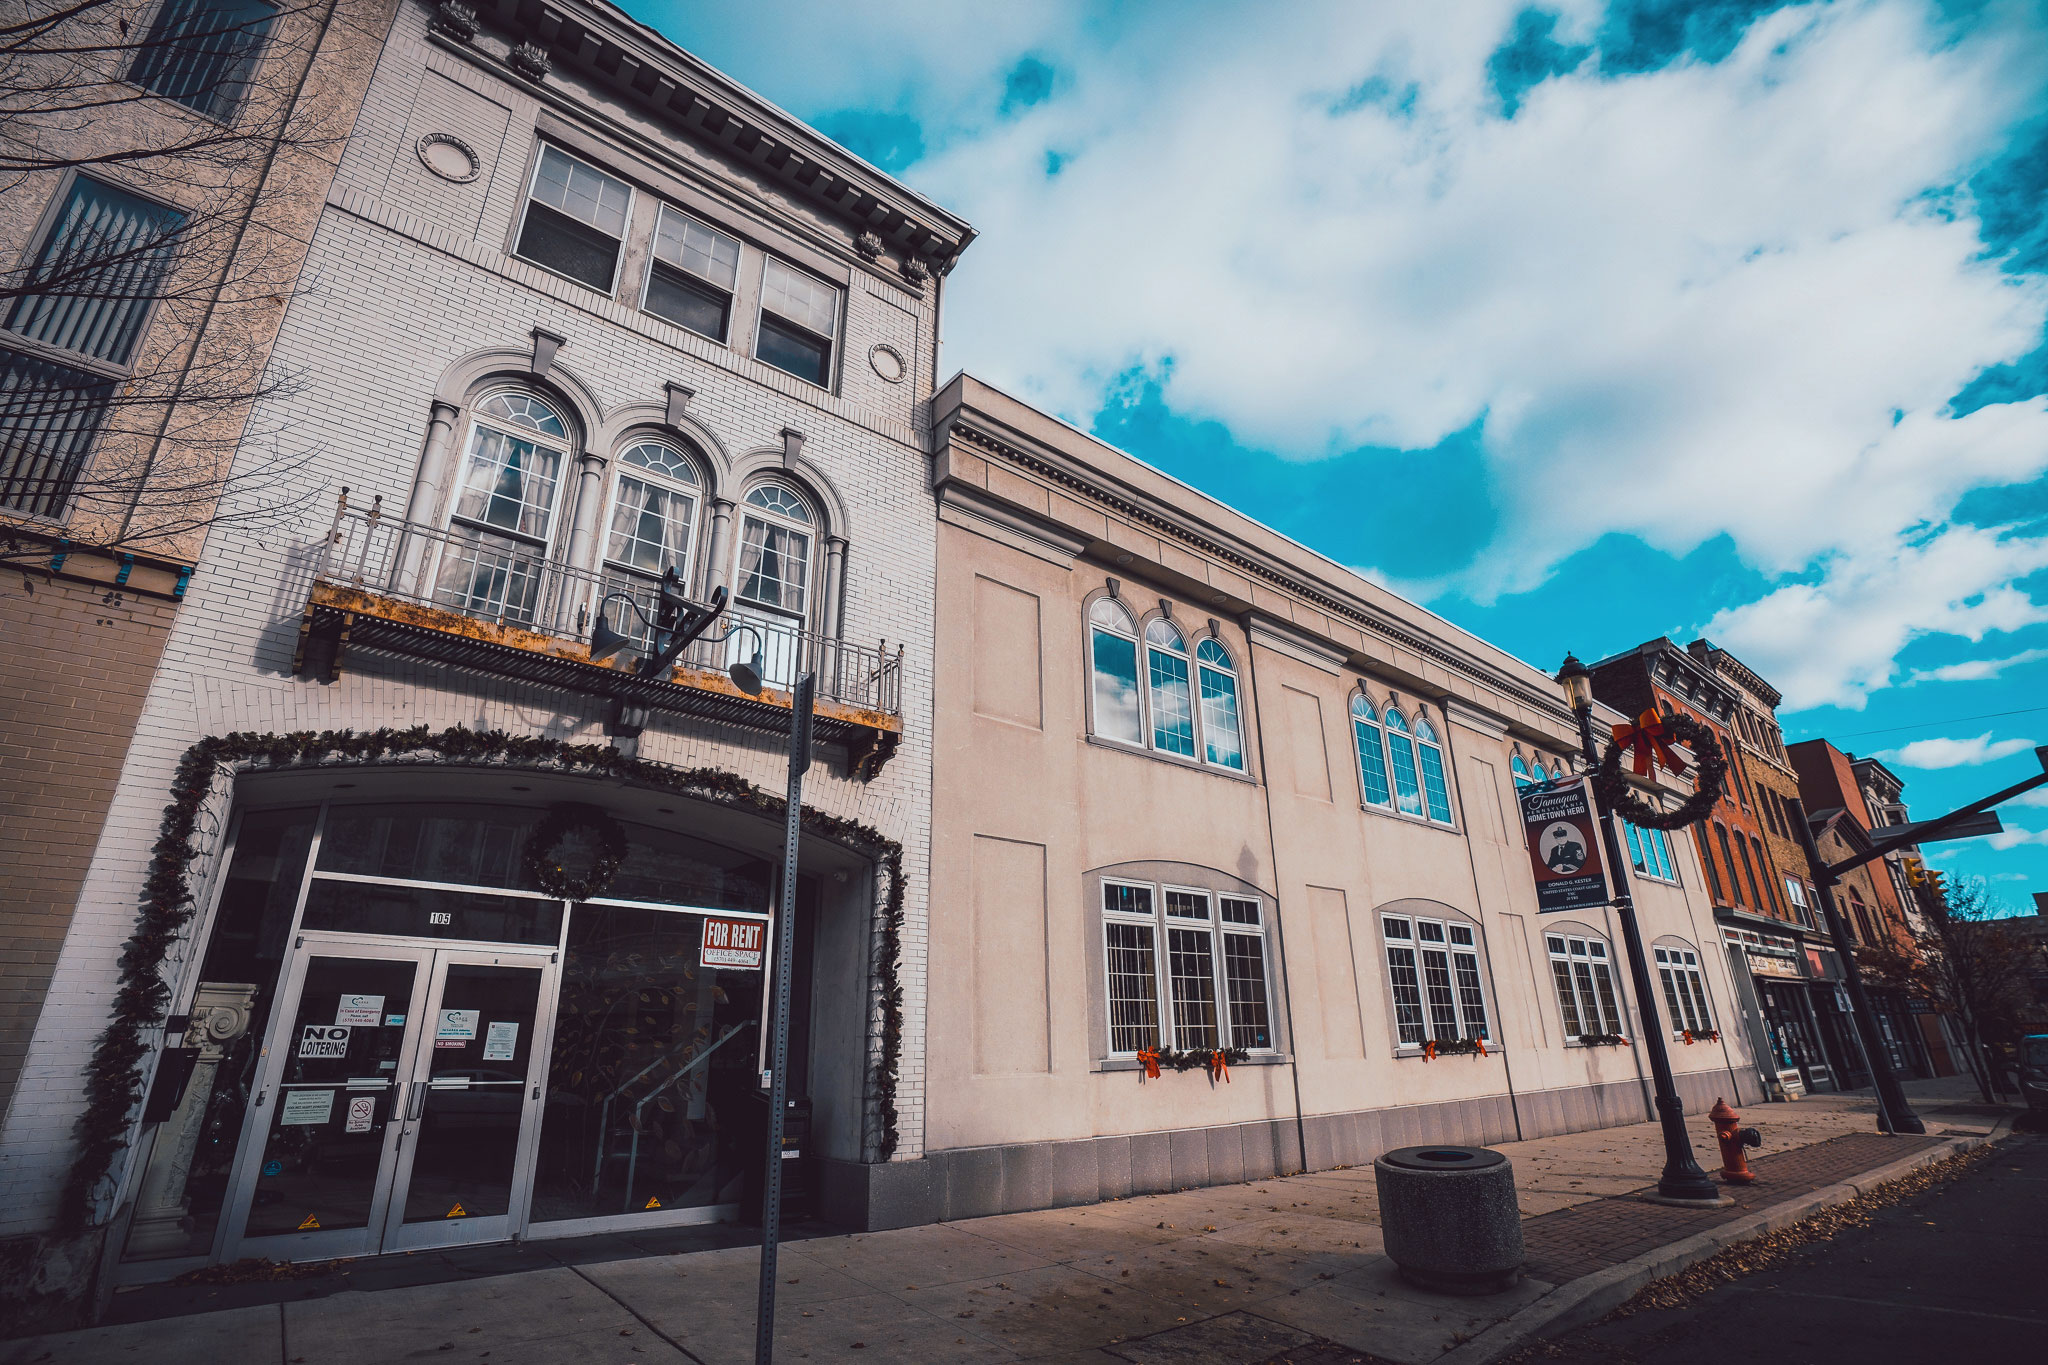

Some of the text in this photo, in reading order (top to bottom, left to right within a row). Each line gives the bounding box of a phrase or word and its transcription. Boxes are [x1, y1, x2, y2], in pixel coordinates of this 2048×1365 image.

[1527, 802, 1583, 815] PENNSYLVANIA
[1528, 794, 1578, 810] Tamaqua
[1528, 806, 1585, 822] HOMETOWN HERO
[433, 914, 449, 923] 105
[707, 922, 760, 949] FOR RENT
[706, 949, 758, 959] OFFICE SPACE
[304, 1028, 348, 1040] NO
[301, 1042, 345, 1055] LOITERING
